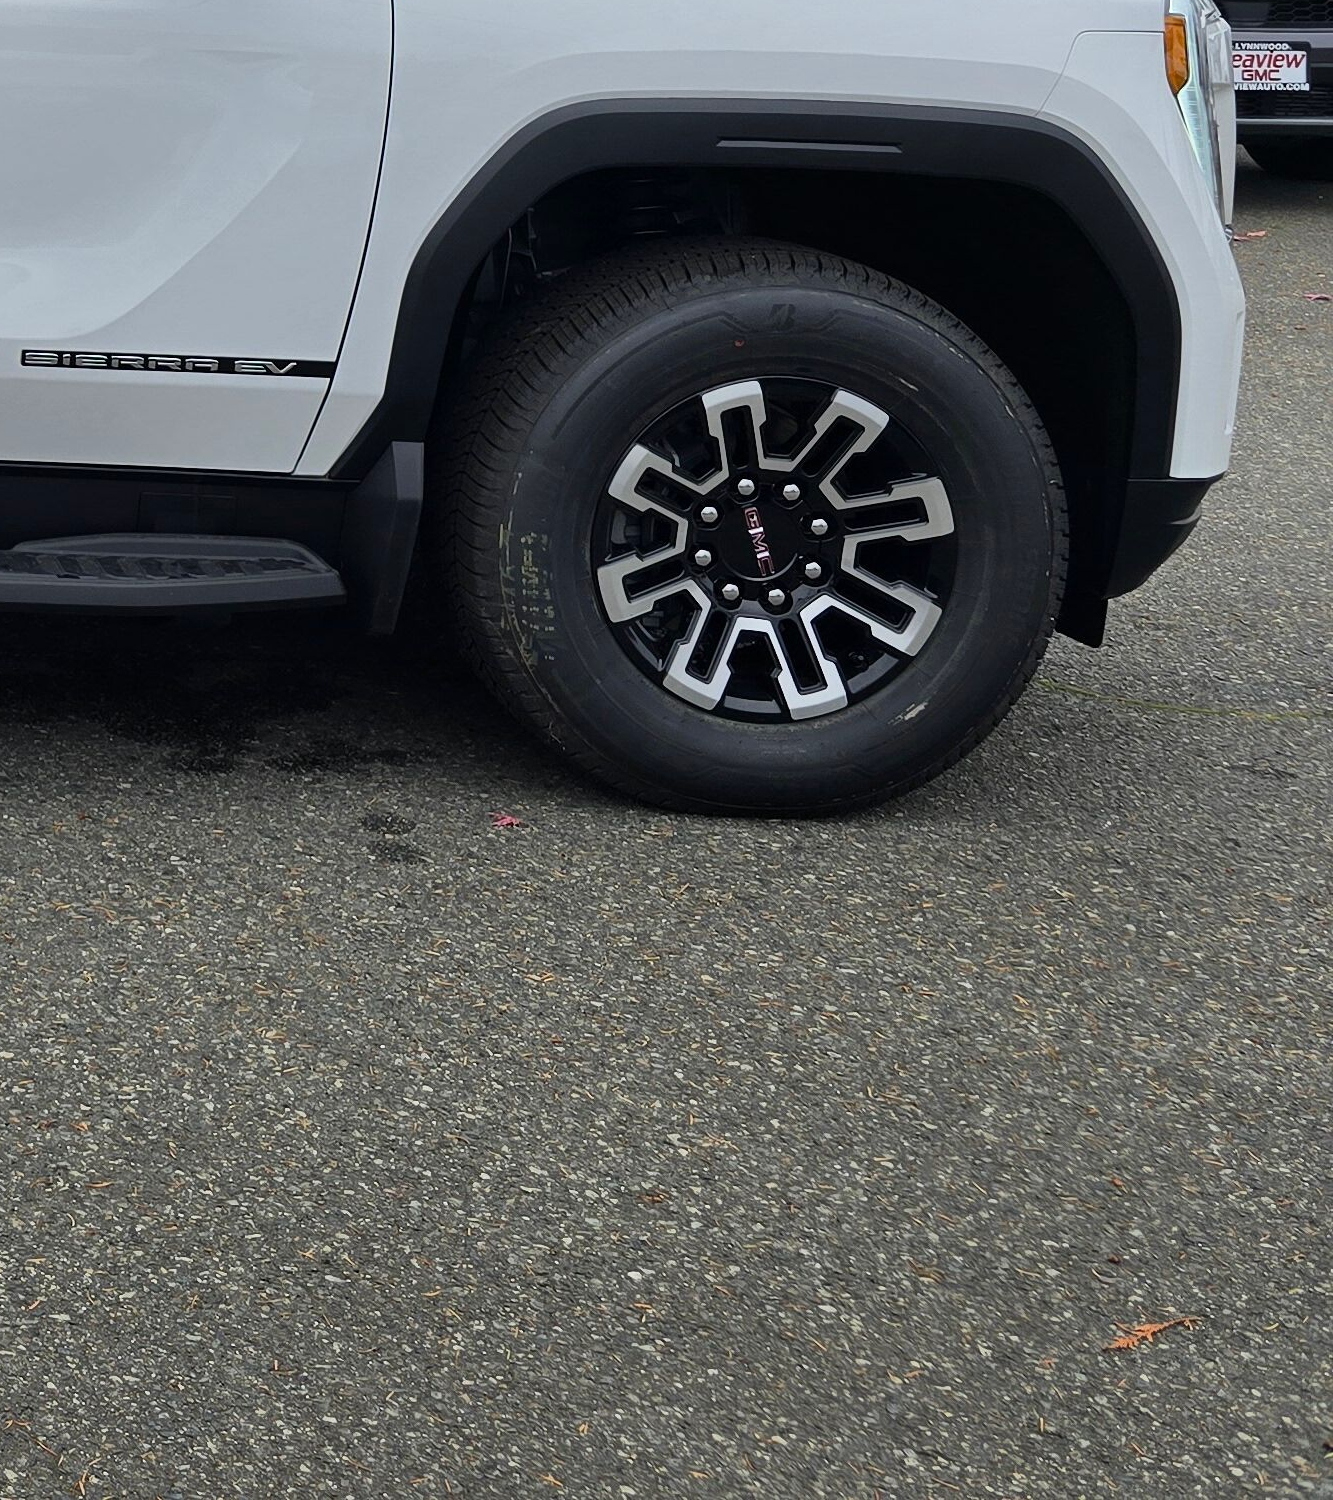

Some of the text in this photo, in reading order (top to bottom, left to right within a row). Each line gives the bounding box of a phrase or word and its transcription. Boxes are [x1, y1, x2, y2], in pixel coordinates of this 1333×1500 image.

[1235, 42, 1290, 51] LYNNWOOD
[1232, 53, 1306, 69] eaview
[1241, 69, 1282, 82] GMC
[1234, 82, 1310, 91] VIEWAUTO.COM
[25, 352, 298, 374] SIERRA EV
[744, 506, 775, 577] GMC
